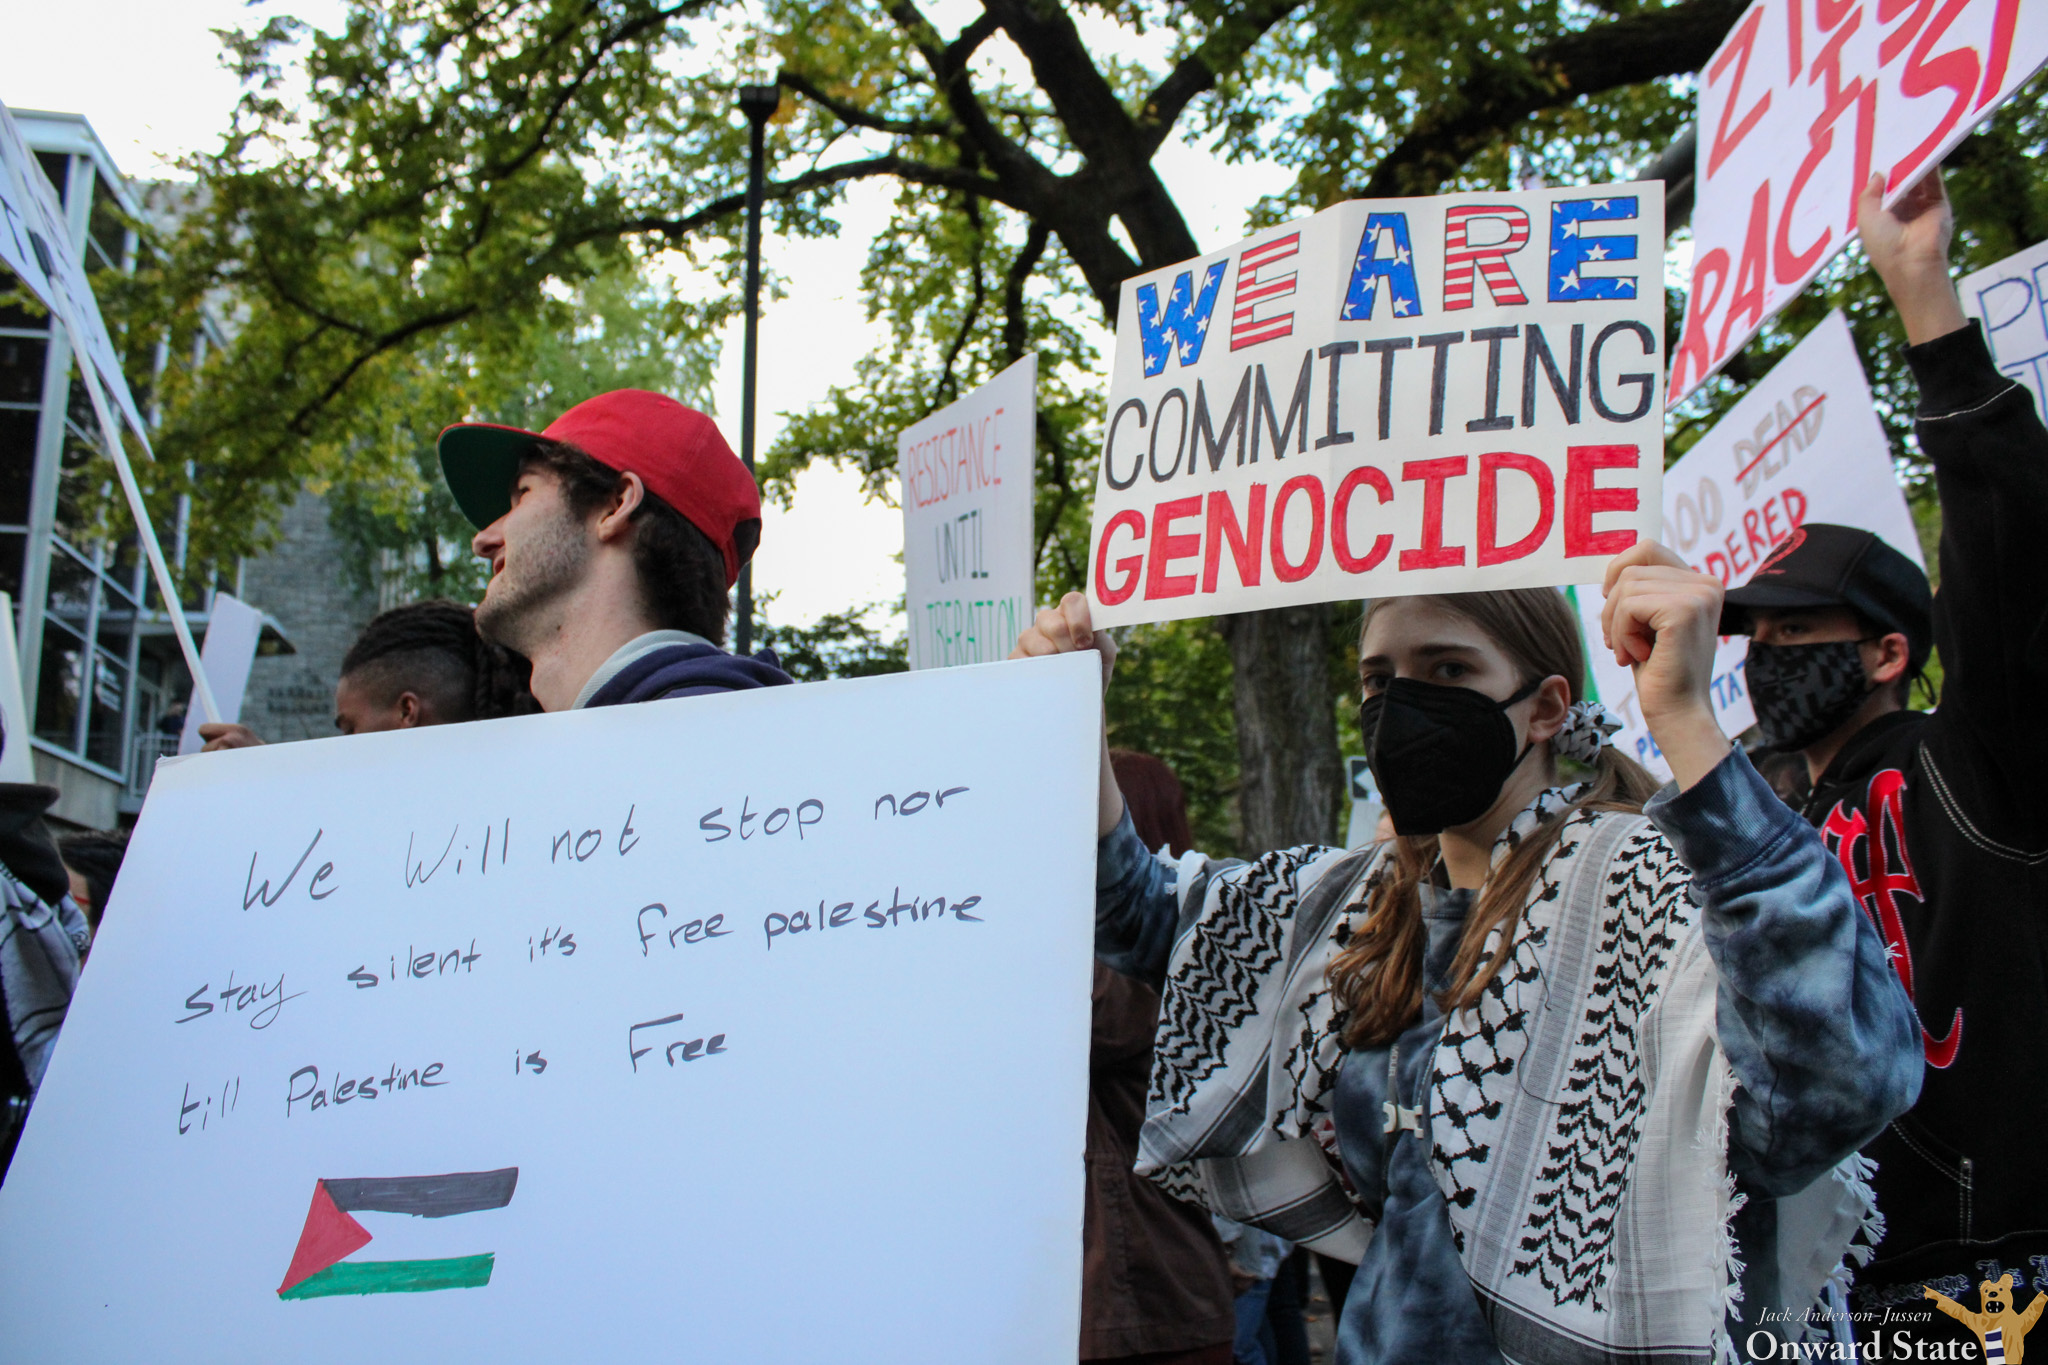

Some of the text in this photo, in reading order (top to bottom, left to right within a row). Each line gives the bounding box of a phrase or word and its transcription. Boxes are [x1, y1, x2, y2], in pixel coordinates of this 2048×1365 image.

[1136, 196, 1639, 379] WE ARE
[908, 408, 1004, 512] RESISTANCE
[1105, 320, 1656, 490] COMMITTING
[1732, 385, 1827, 500] DEAD
[935, 508, 989, 584] UNTIL
[1095, 444, 1640, 606] GENOCIDE
[1691, 488, 1807, 587] DERED
[243, 786, 970, 911] We Will not stop nor
[174, 970, 309, 1030] stay
[347, 938, 482, 989] silent
[528, 925, 577, 963] it's
[764, 886, 985, 951] palestine
[179, 1012, 728, 1135] till Palestine is Free
